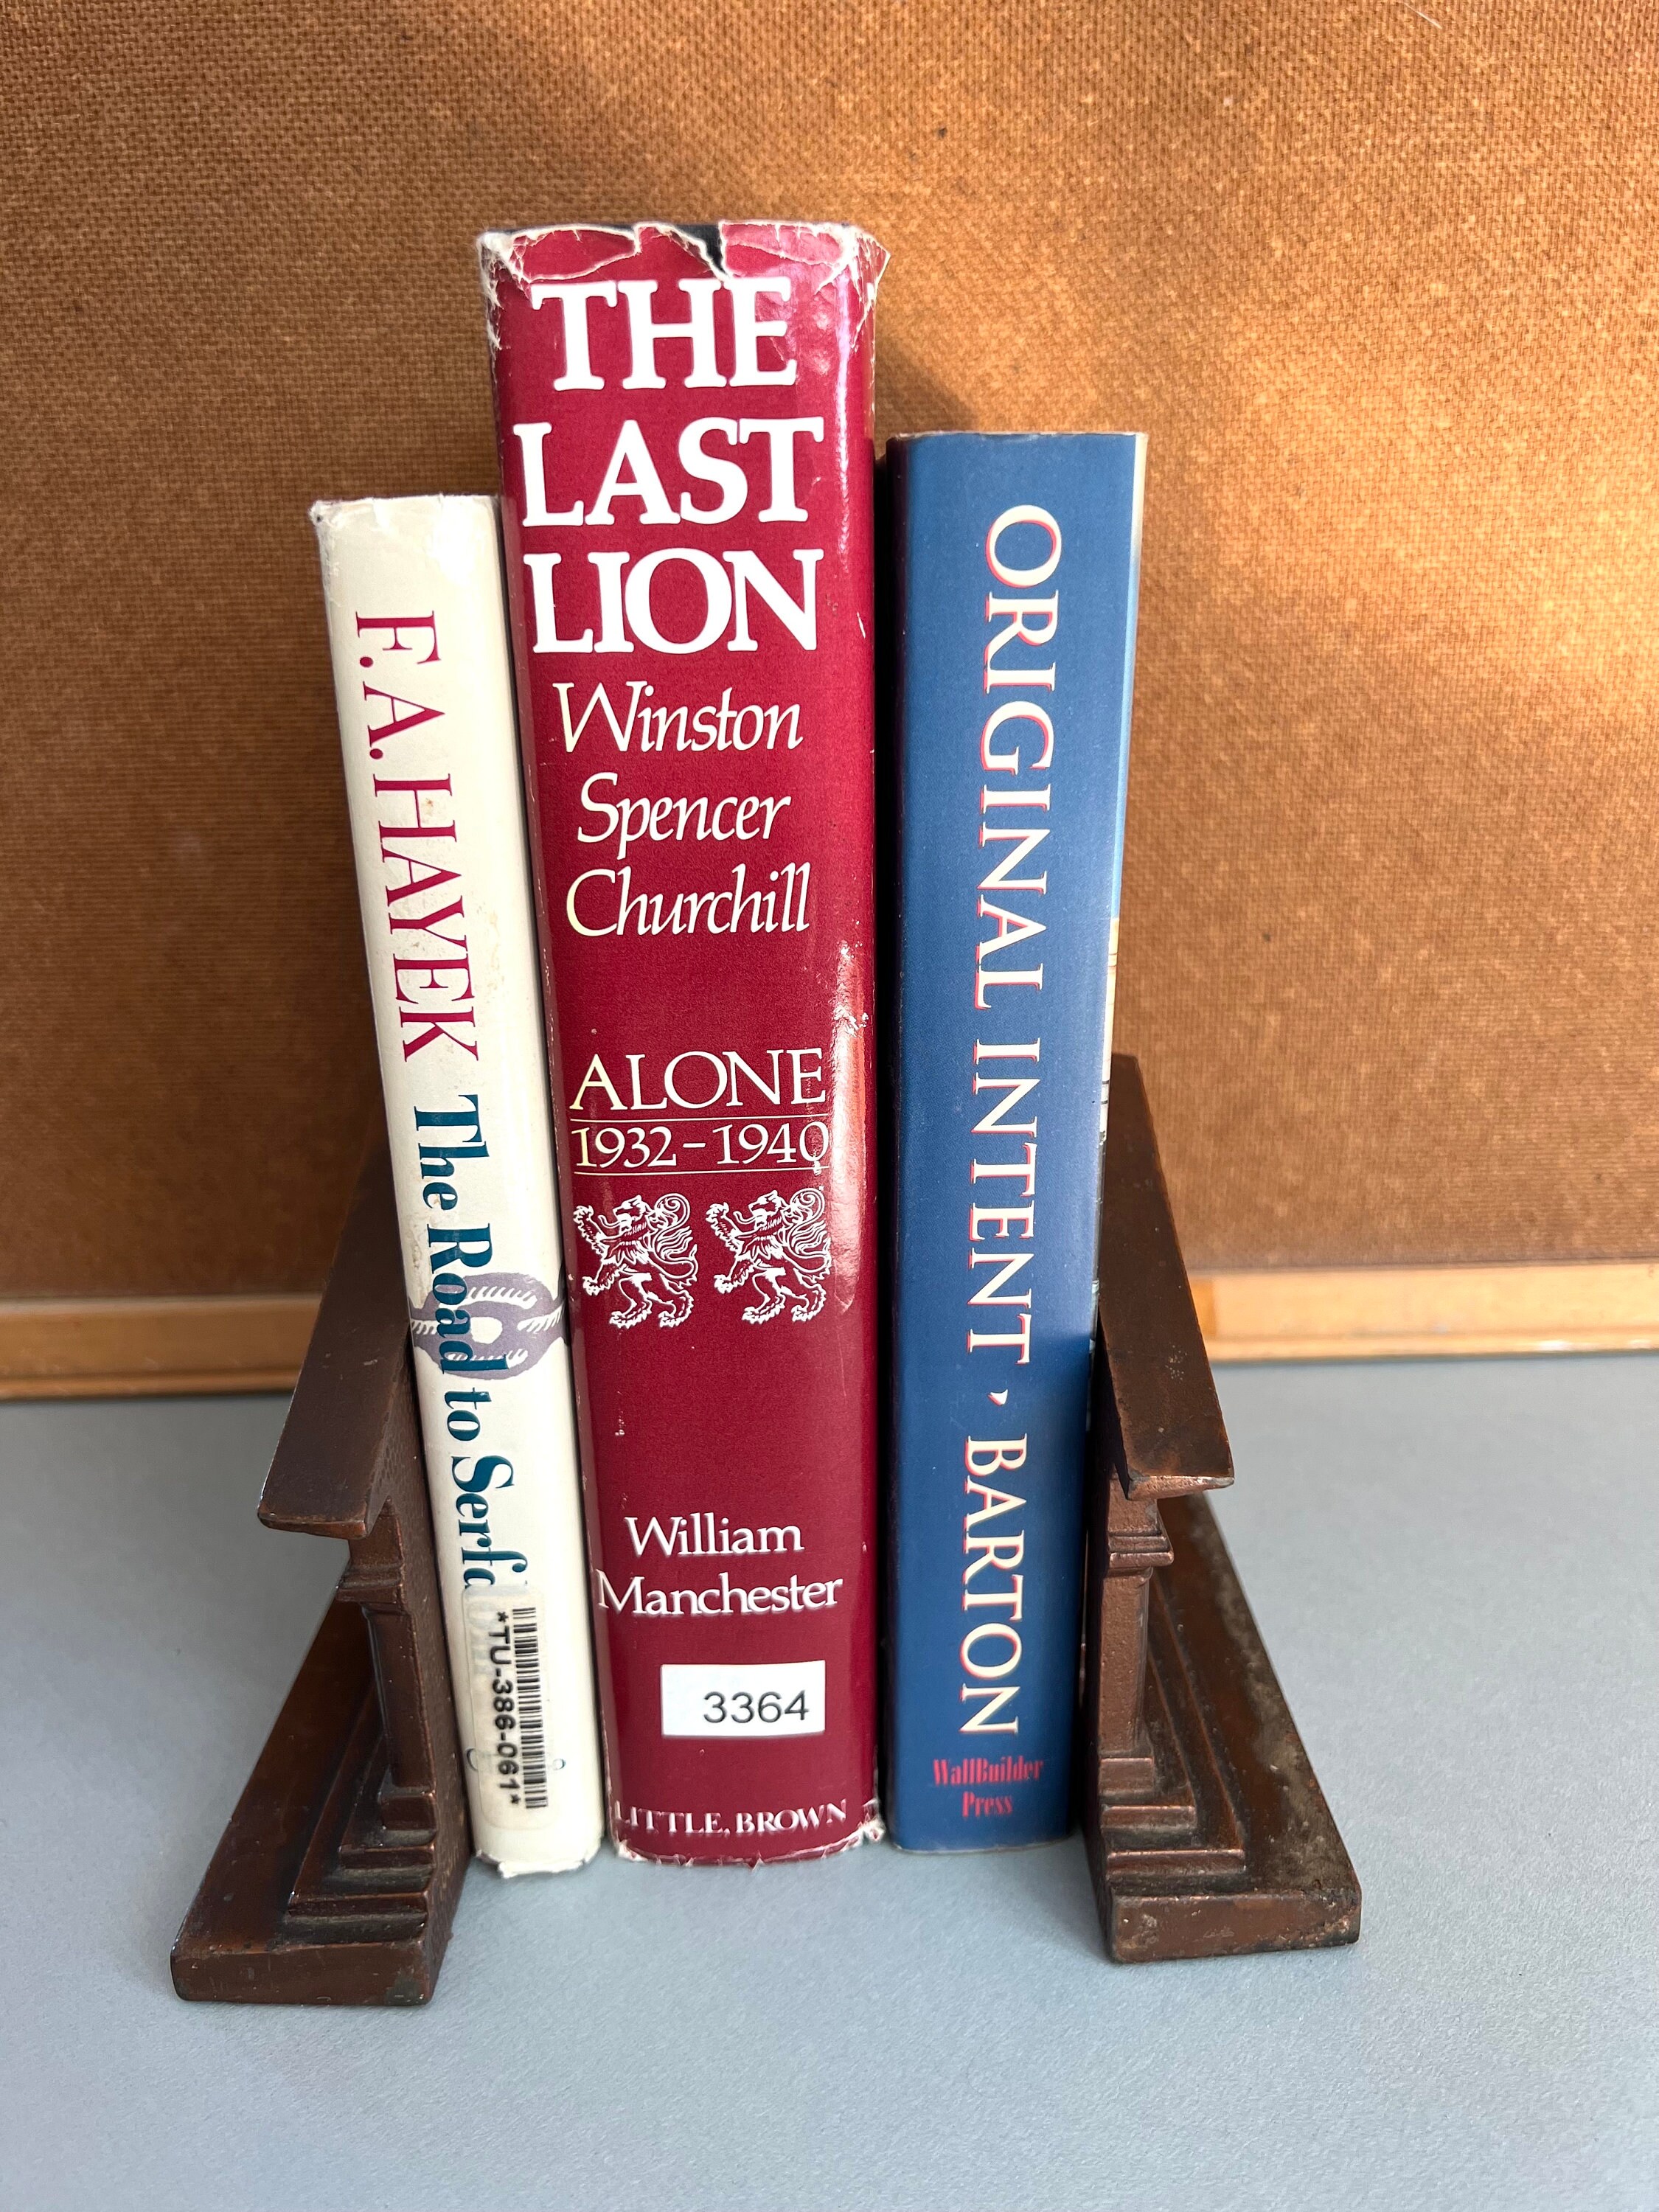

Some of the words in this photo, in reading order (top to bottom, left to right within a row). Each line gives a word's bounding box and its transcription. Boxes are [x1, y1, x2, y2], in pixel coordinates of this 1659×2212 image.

[531, 276, 797, 391] THE
[512, 417, 824, 526] LAST
[523, 547, 824, 654] LION
[552, 681, 803, 752] Winston
[973, 504, 1062, 1009] ORIGINAL
[577, 772, 791, 860] Spencer
[566, 861, 810, 936] Churchill
[569, 1048, 826, 1110] ALONE
[414, 1094, 490, 1211] The
[967, 1038, 1041, 1365] INTENT
[427, 1222, 509, 1374] Road
[444, 1387, 492, 1441] to
[625, 1512, 805, 1558] William
[596, 1569, 844, 1615] Manchester
[959, 1433, 1028, 1735] BARTON
[703, 1690, 809, 1724] 3364
[933, 1755, 1044, 1786] WallBuilder
[962, 1790, 1012, 1818] Press
[736, 1798, 847, 1834] BROWN
